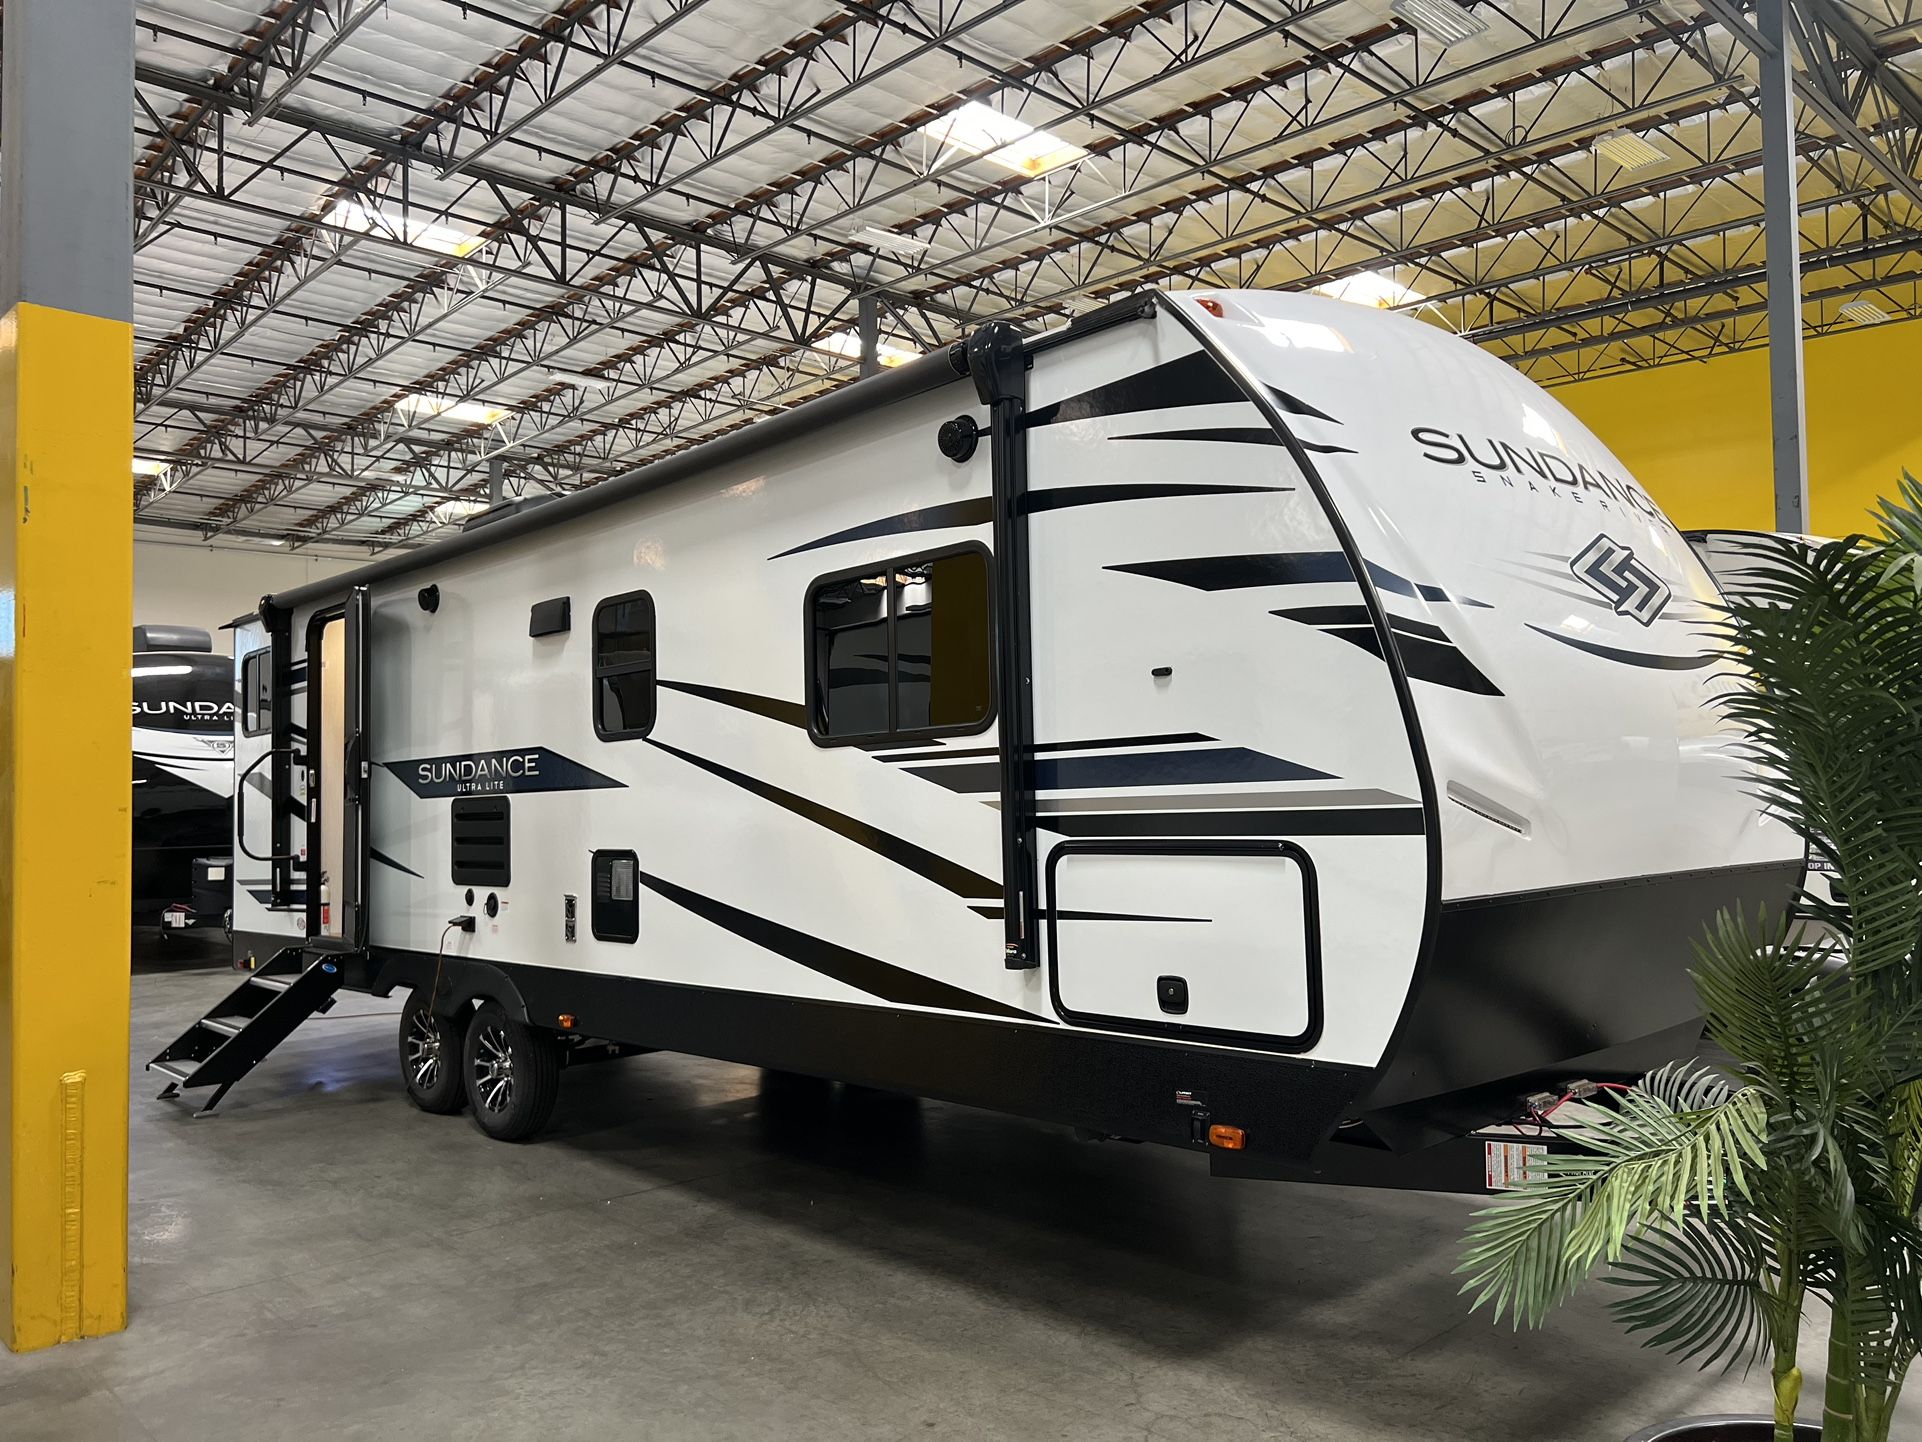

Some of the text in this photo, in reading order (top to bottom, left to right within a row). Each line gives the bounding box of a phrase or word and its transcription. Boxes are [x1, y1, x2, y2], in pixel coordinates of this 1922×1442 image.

[1410, 427, 1673, 530] SUNDANCE
[1472, 470, 1583, 504] SNAKE
[418, 754, 540, 784] SUNDANCE
[457, 780, 504, 792] ULTRA LITE
